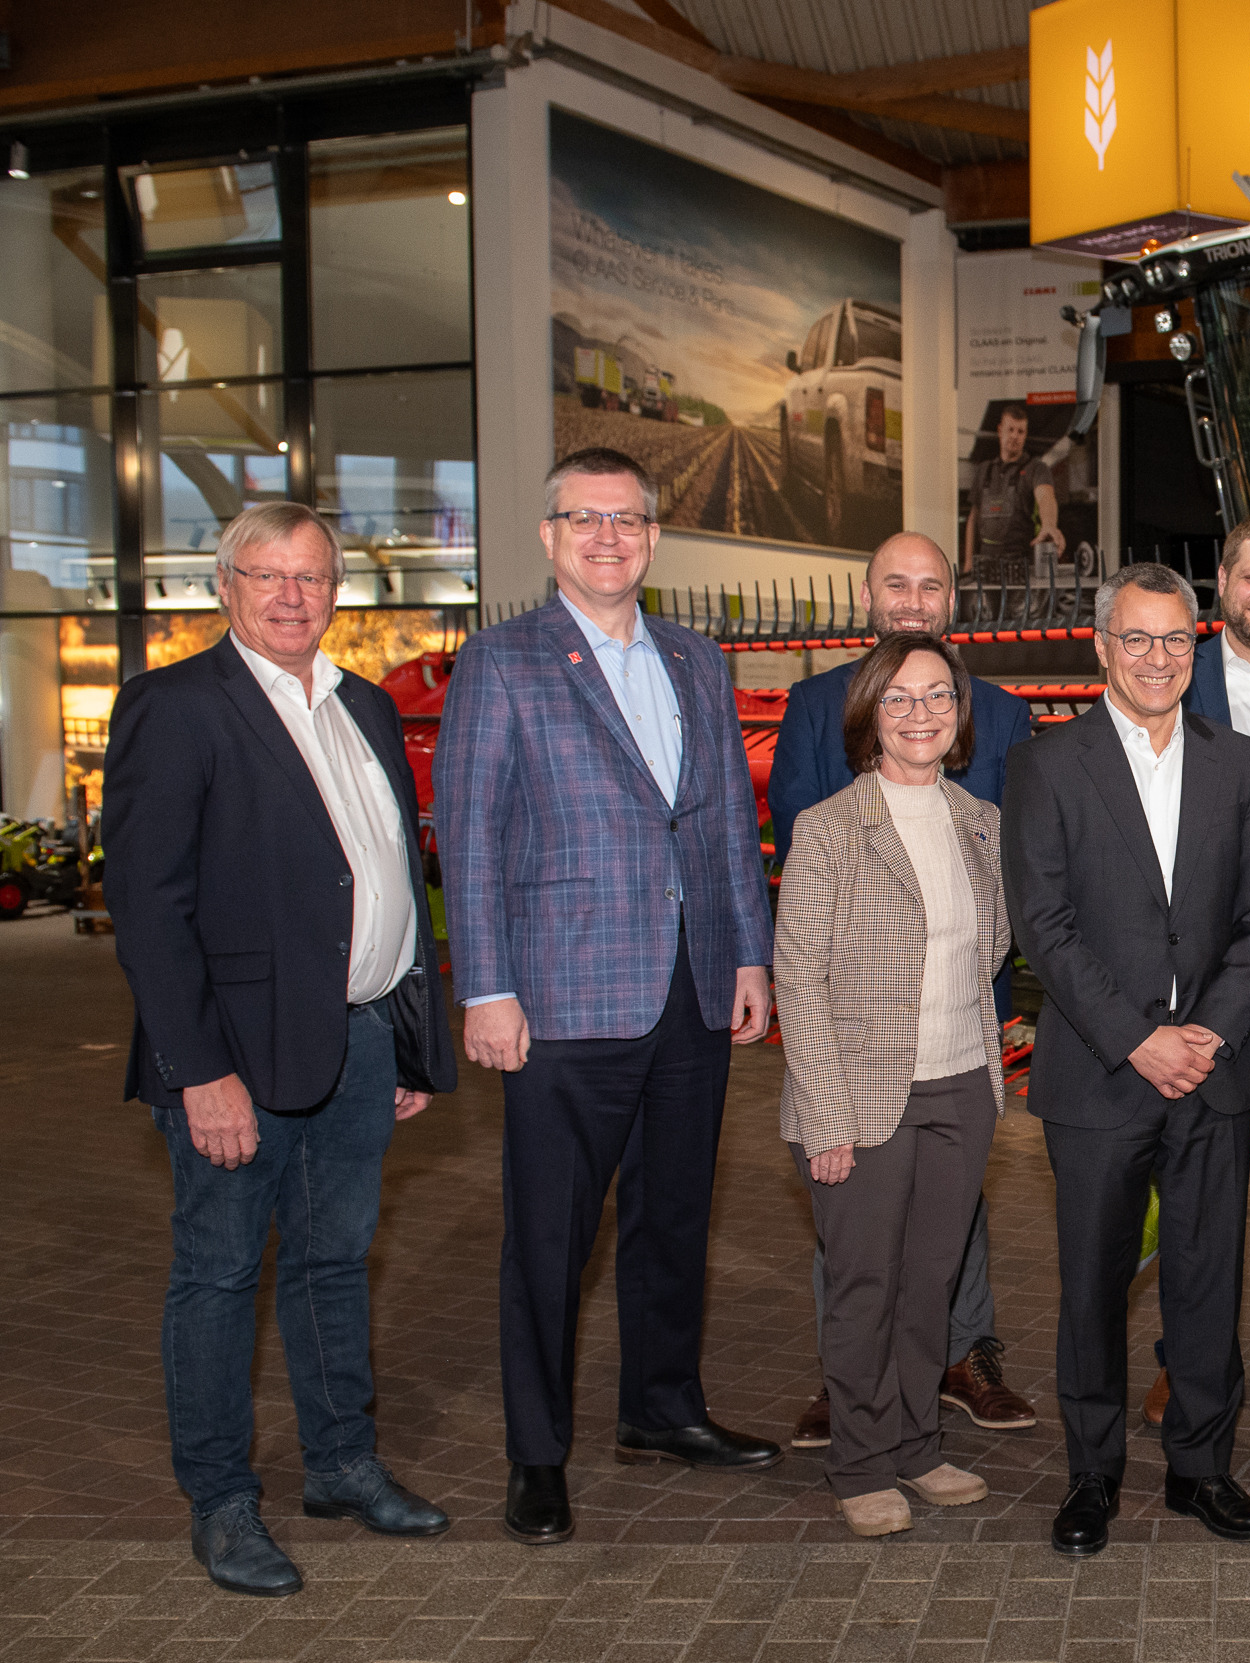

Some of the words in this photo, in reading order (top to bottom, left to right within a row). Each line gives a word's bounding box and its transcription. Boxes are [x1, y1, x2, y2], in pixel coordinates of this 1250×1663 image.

[571, 250, 629, 286] CLAAS
[632, 266, 686, 302] Service
[567, 651, 583, 665] N
